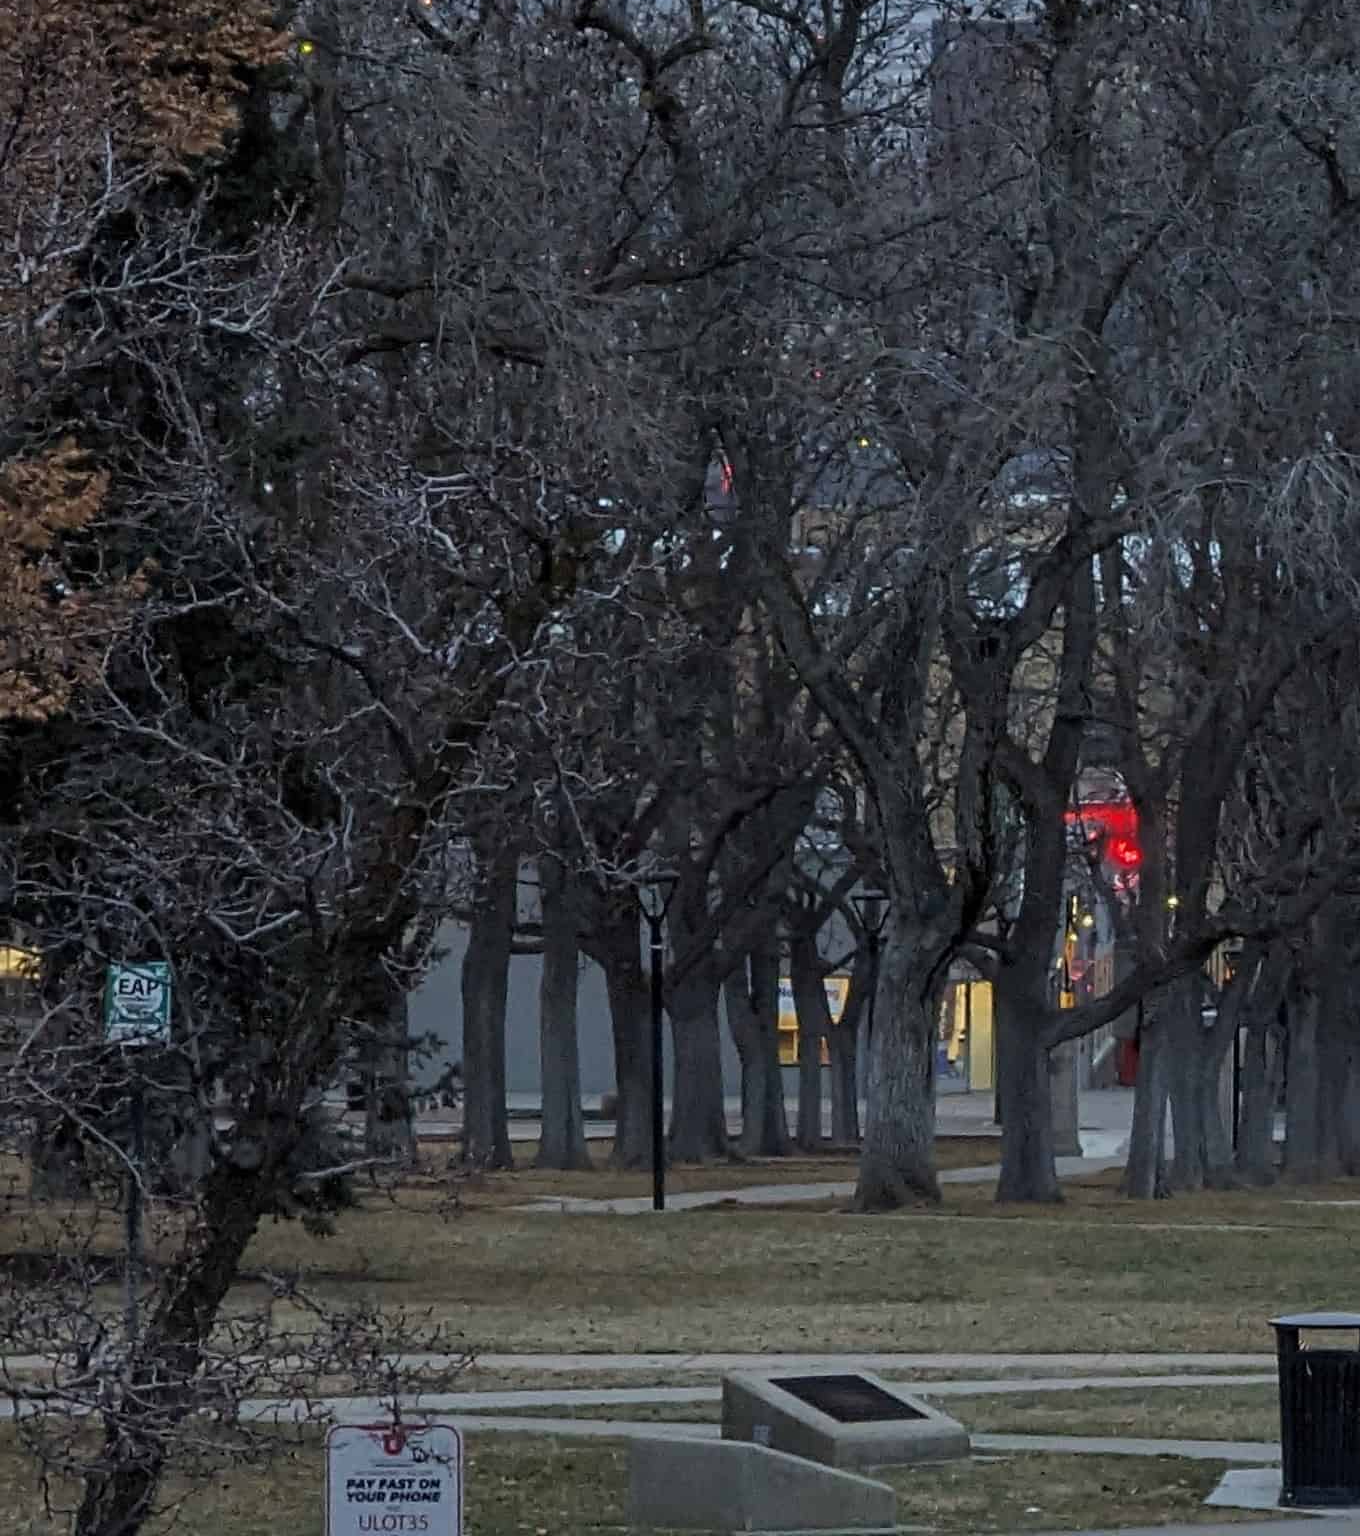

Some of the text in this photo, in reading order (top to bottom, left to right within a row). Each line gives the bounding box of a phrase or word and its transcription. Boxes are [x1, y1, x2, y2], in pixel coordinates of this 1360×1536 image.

[119, 978, 159, 995] EAP
[346, 1479, 440, 1489] PAY FAST ON
[347, 1492, 440, 1502] YOUR PHONE
[359, 1513, 429, 1532] ULOT35
